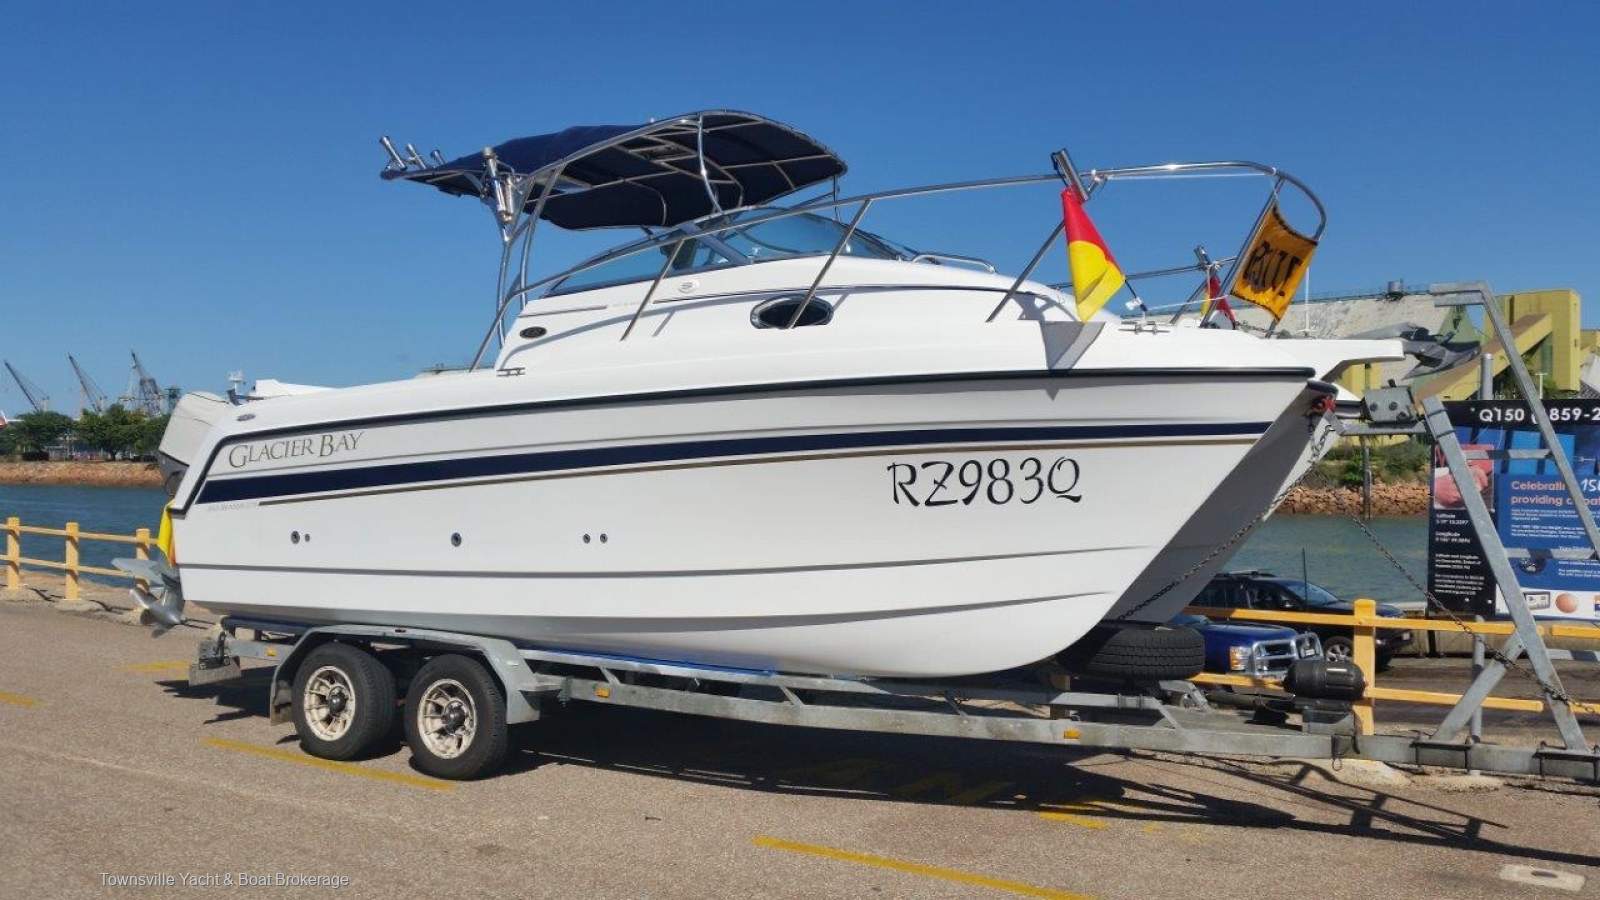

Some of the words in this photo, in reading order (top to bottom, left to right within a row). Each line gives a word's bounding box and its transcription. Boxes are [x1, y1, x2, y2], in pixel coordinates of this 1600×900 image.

[1479, 407, 1525, 423] Q150
[228, 439, 315, 468] GLACIER
[319, 433, 364, 457] BAY
[887, 456, 1082, 506] RZ983Q
[1582, 477, 1600, 492] 15
[1511, 495, 1563, 506] providing
